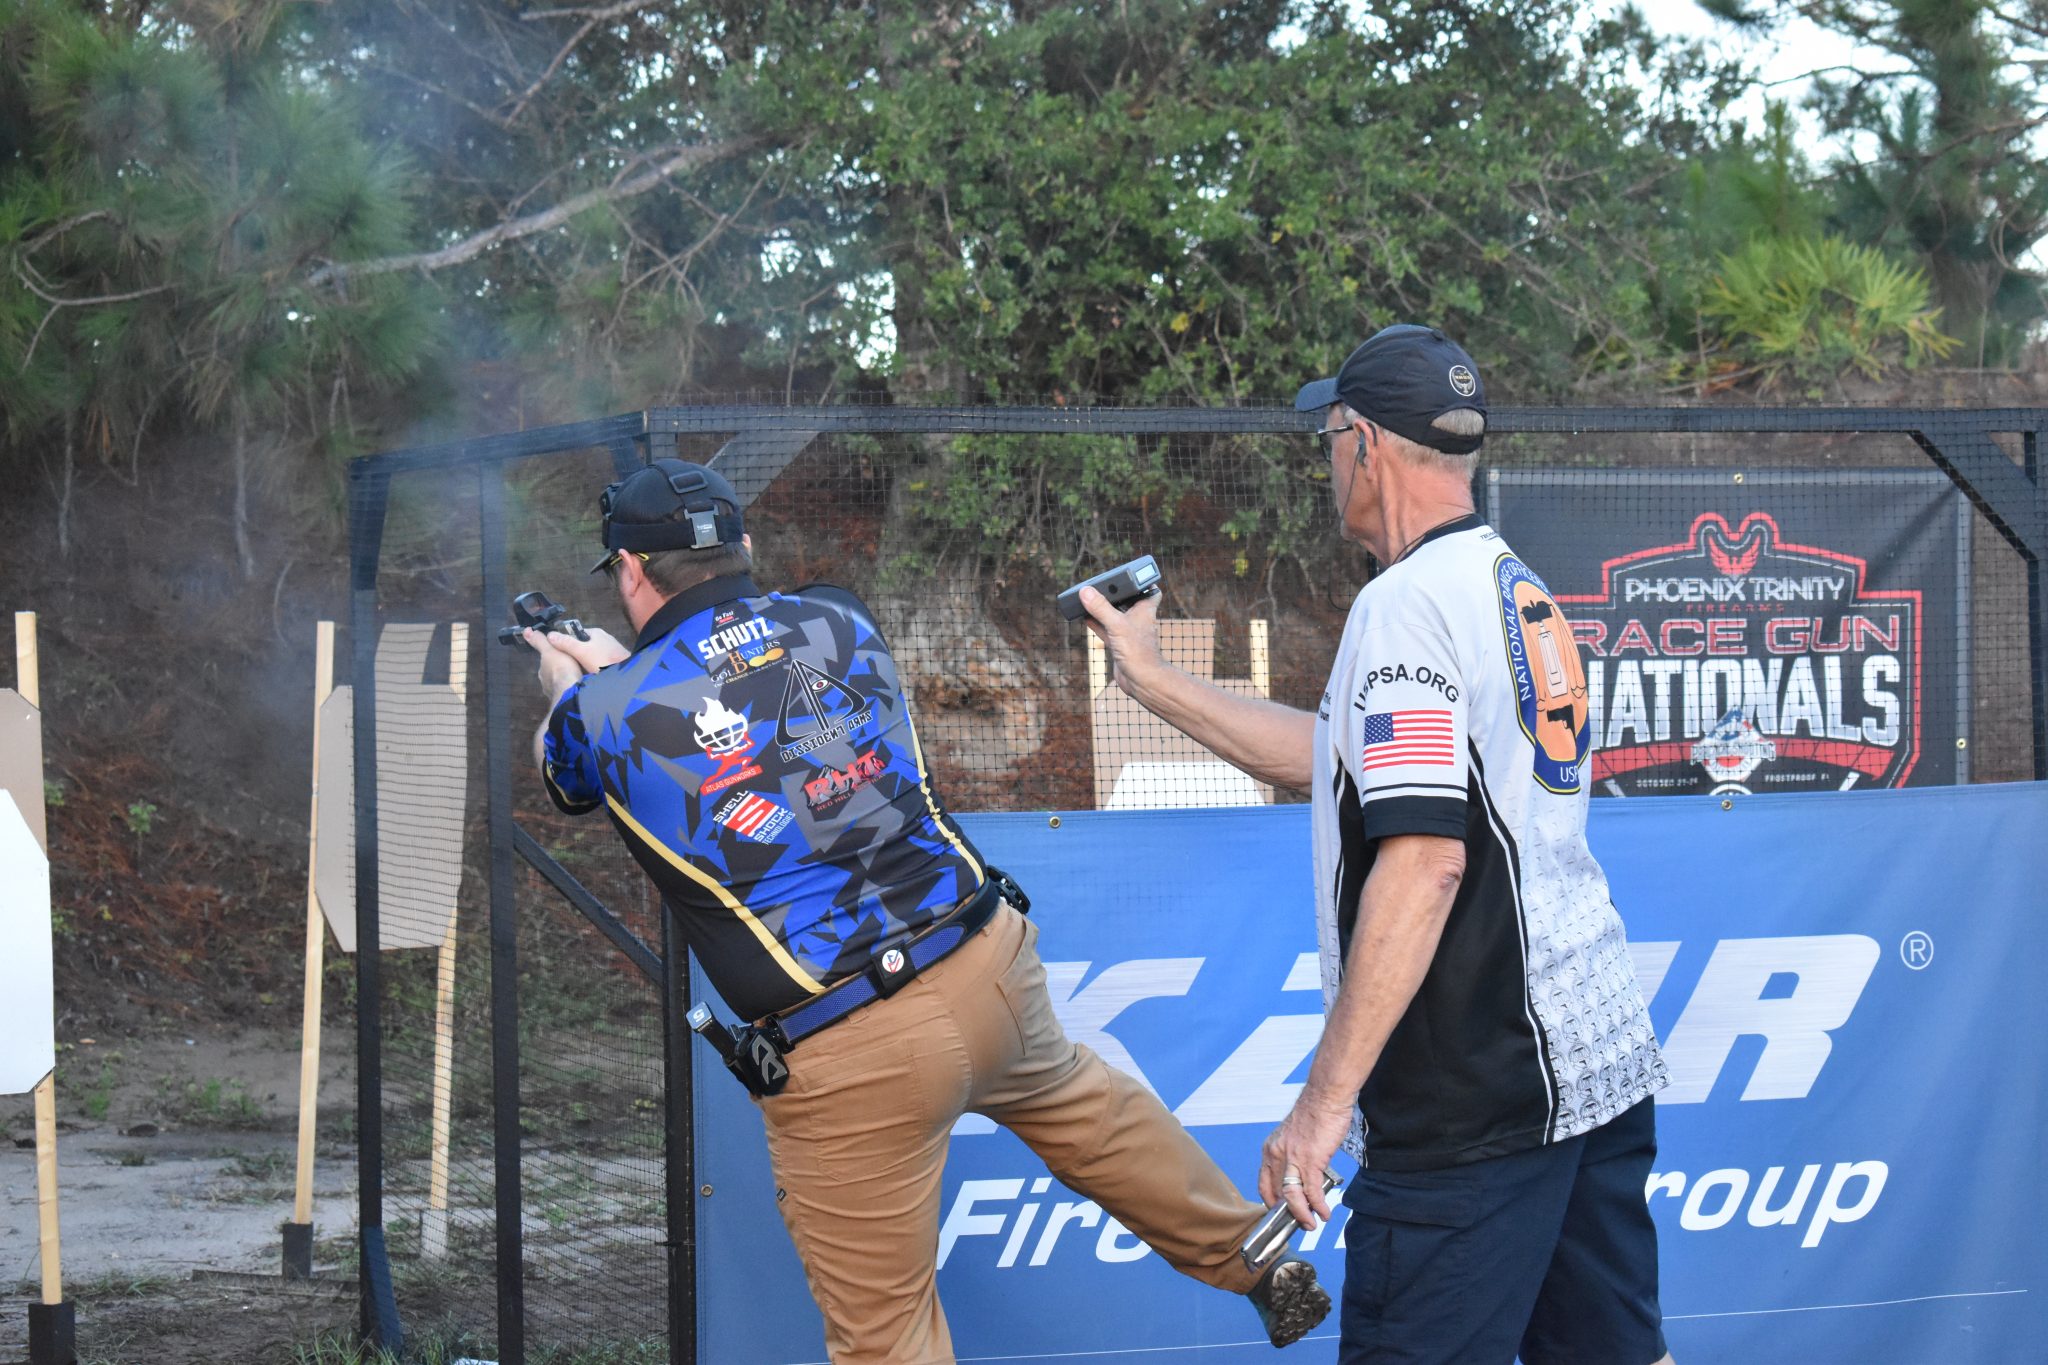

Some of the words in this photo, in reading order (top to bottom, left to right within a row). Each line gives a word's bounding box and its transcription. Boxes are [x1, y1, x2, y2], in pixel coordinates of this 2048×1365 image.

[1625, 577, 1746, 602] PHOENIX
[1749, 576, 1845, 601] TRINITY
[1686, 603, 1785, 613] FIREARMS
[697, 617, 773, 660] SCHUTZ
[729, 640, 780, 663] HUNTERS
[1566, 619, 1748, 656] RACE
[1765, 615, 1900, 654] GUN
[1504, 606, 1532, 702] NATIONAL
[705, 781, 725, 793] ATLAS
[713, 790, 749, 823] SHELL
[753, 807, 789, 842] SHOCK
[1645, 1160, 1889, 1248] roup
